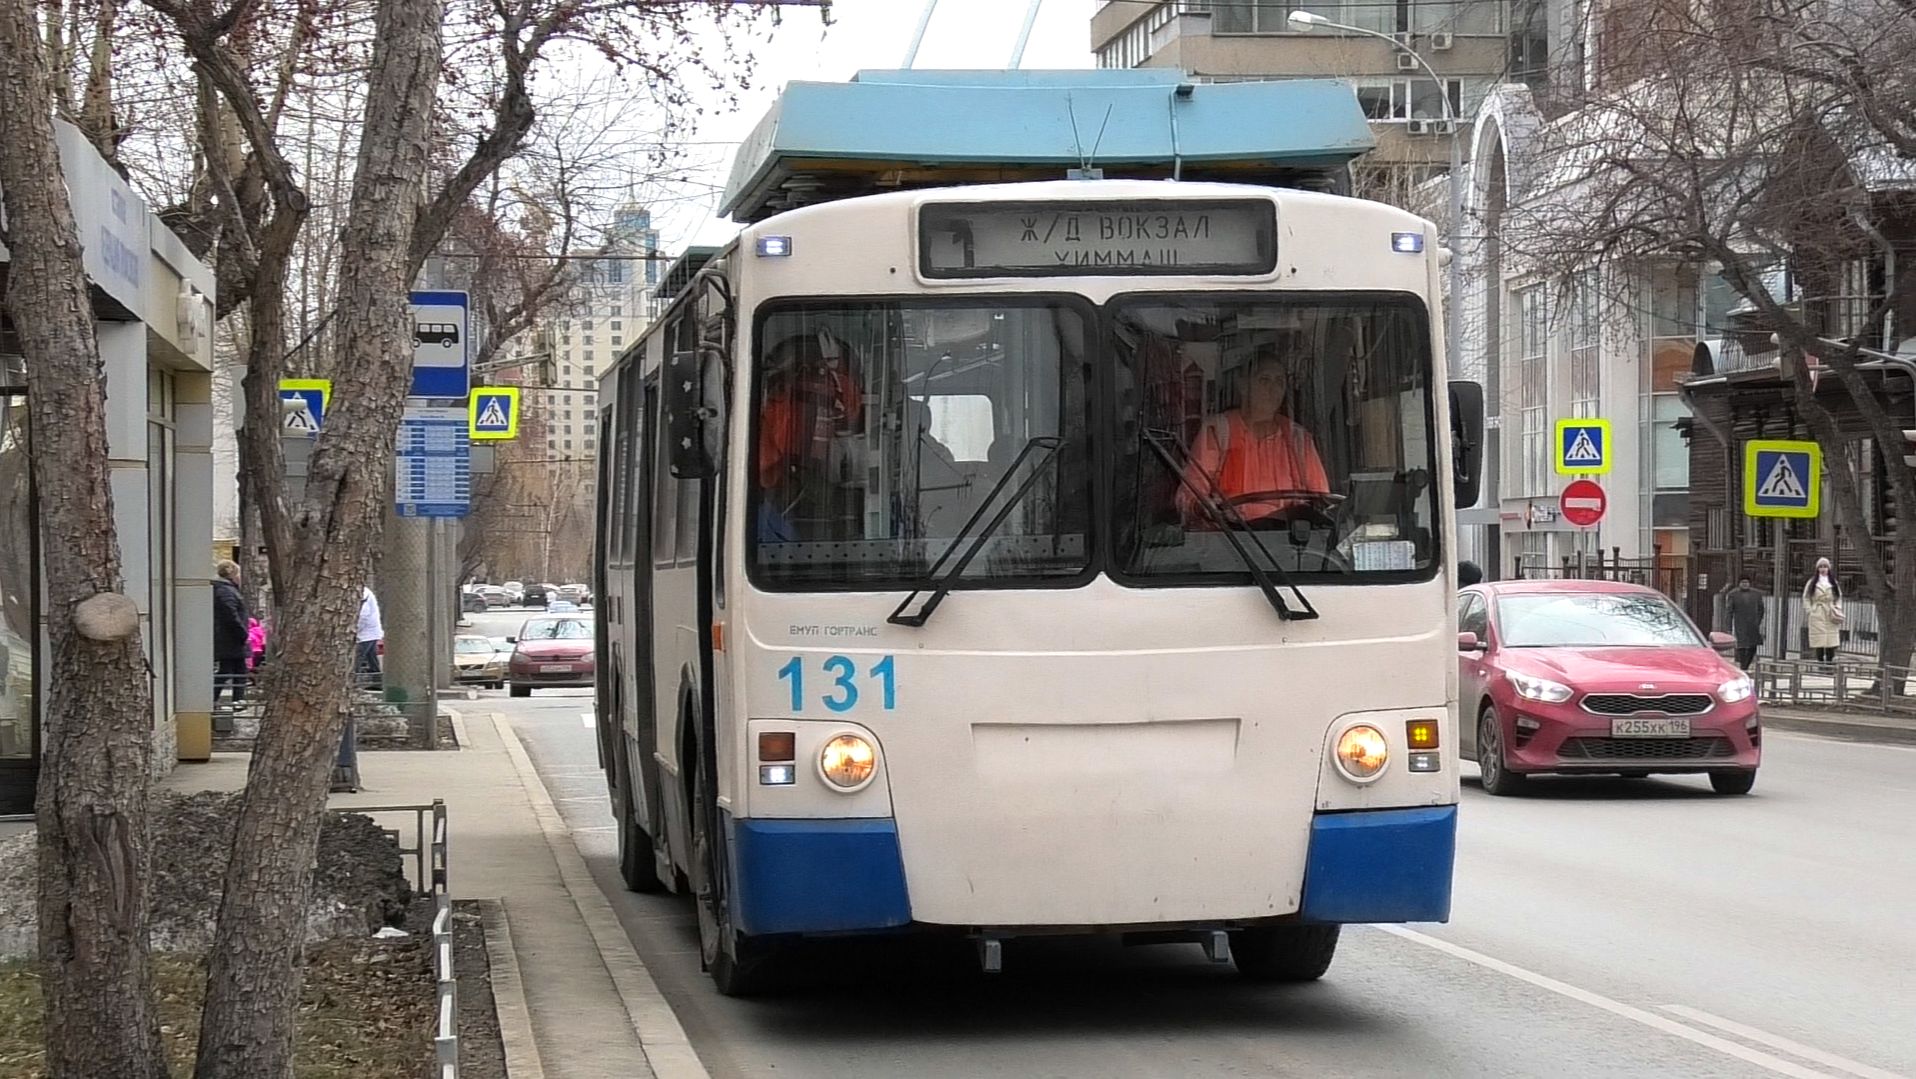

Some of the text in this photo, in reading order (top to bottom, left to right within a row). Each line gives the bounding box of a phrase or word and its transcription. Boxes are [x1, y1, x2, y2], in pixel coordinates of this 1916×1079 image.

[1020, 213, 1210, 243] Ж/Д ВОКЗАЛ
[789, 625, 878, 636] ЕМУП ГОРТРАНС
[778, 654, 896, 712] 131
[1616, 720, 1688, 734] К255ХК 196
